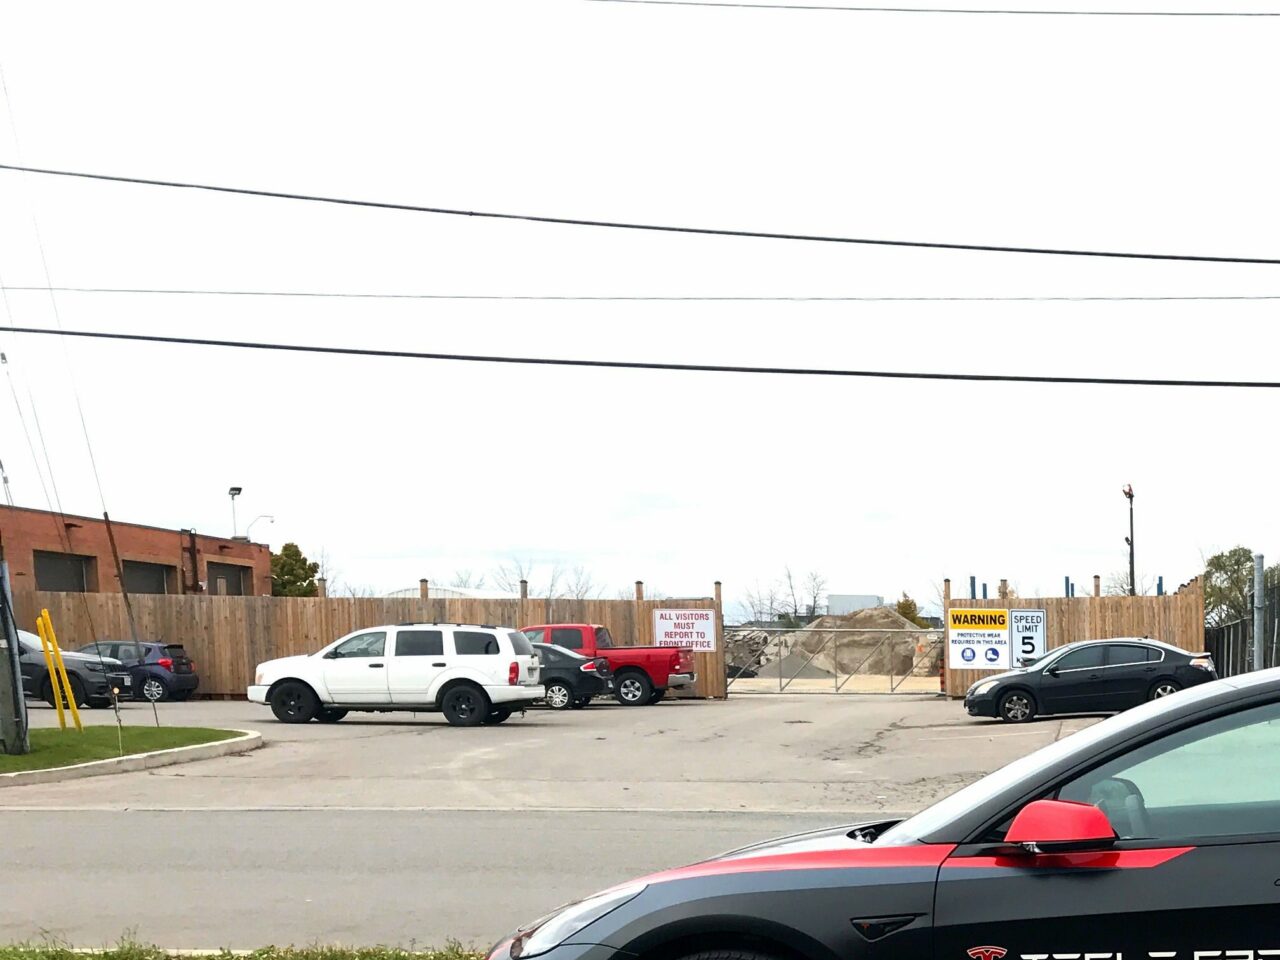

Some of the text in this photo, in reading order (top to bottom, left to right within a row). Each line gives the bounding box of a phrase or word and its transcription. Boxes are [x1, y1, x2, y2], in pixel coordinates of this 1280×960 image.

[659, 613, 710, 621] ALL VISITORS
[952, 614, 1006, 625] WARNING
[1014, 615, 1042, 624] SPEED
[673, 622, 695, 630] MUST
[1016, 625, 1039, 633] LIMIT
[664, 631, 706, 639] REPORT TO
[685, 640, 711, 648] OFFICE
[1021, 636, 1035, 654] 5
